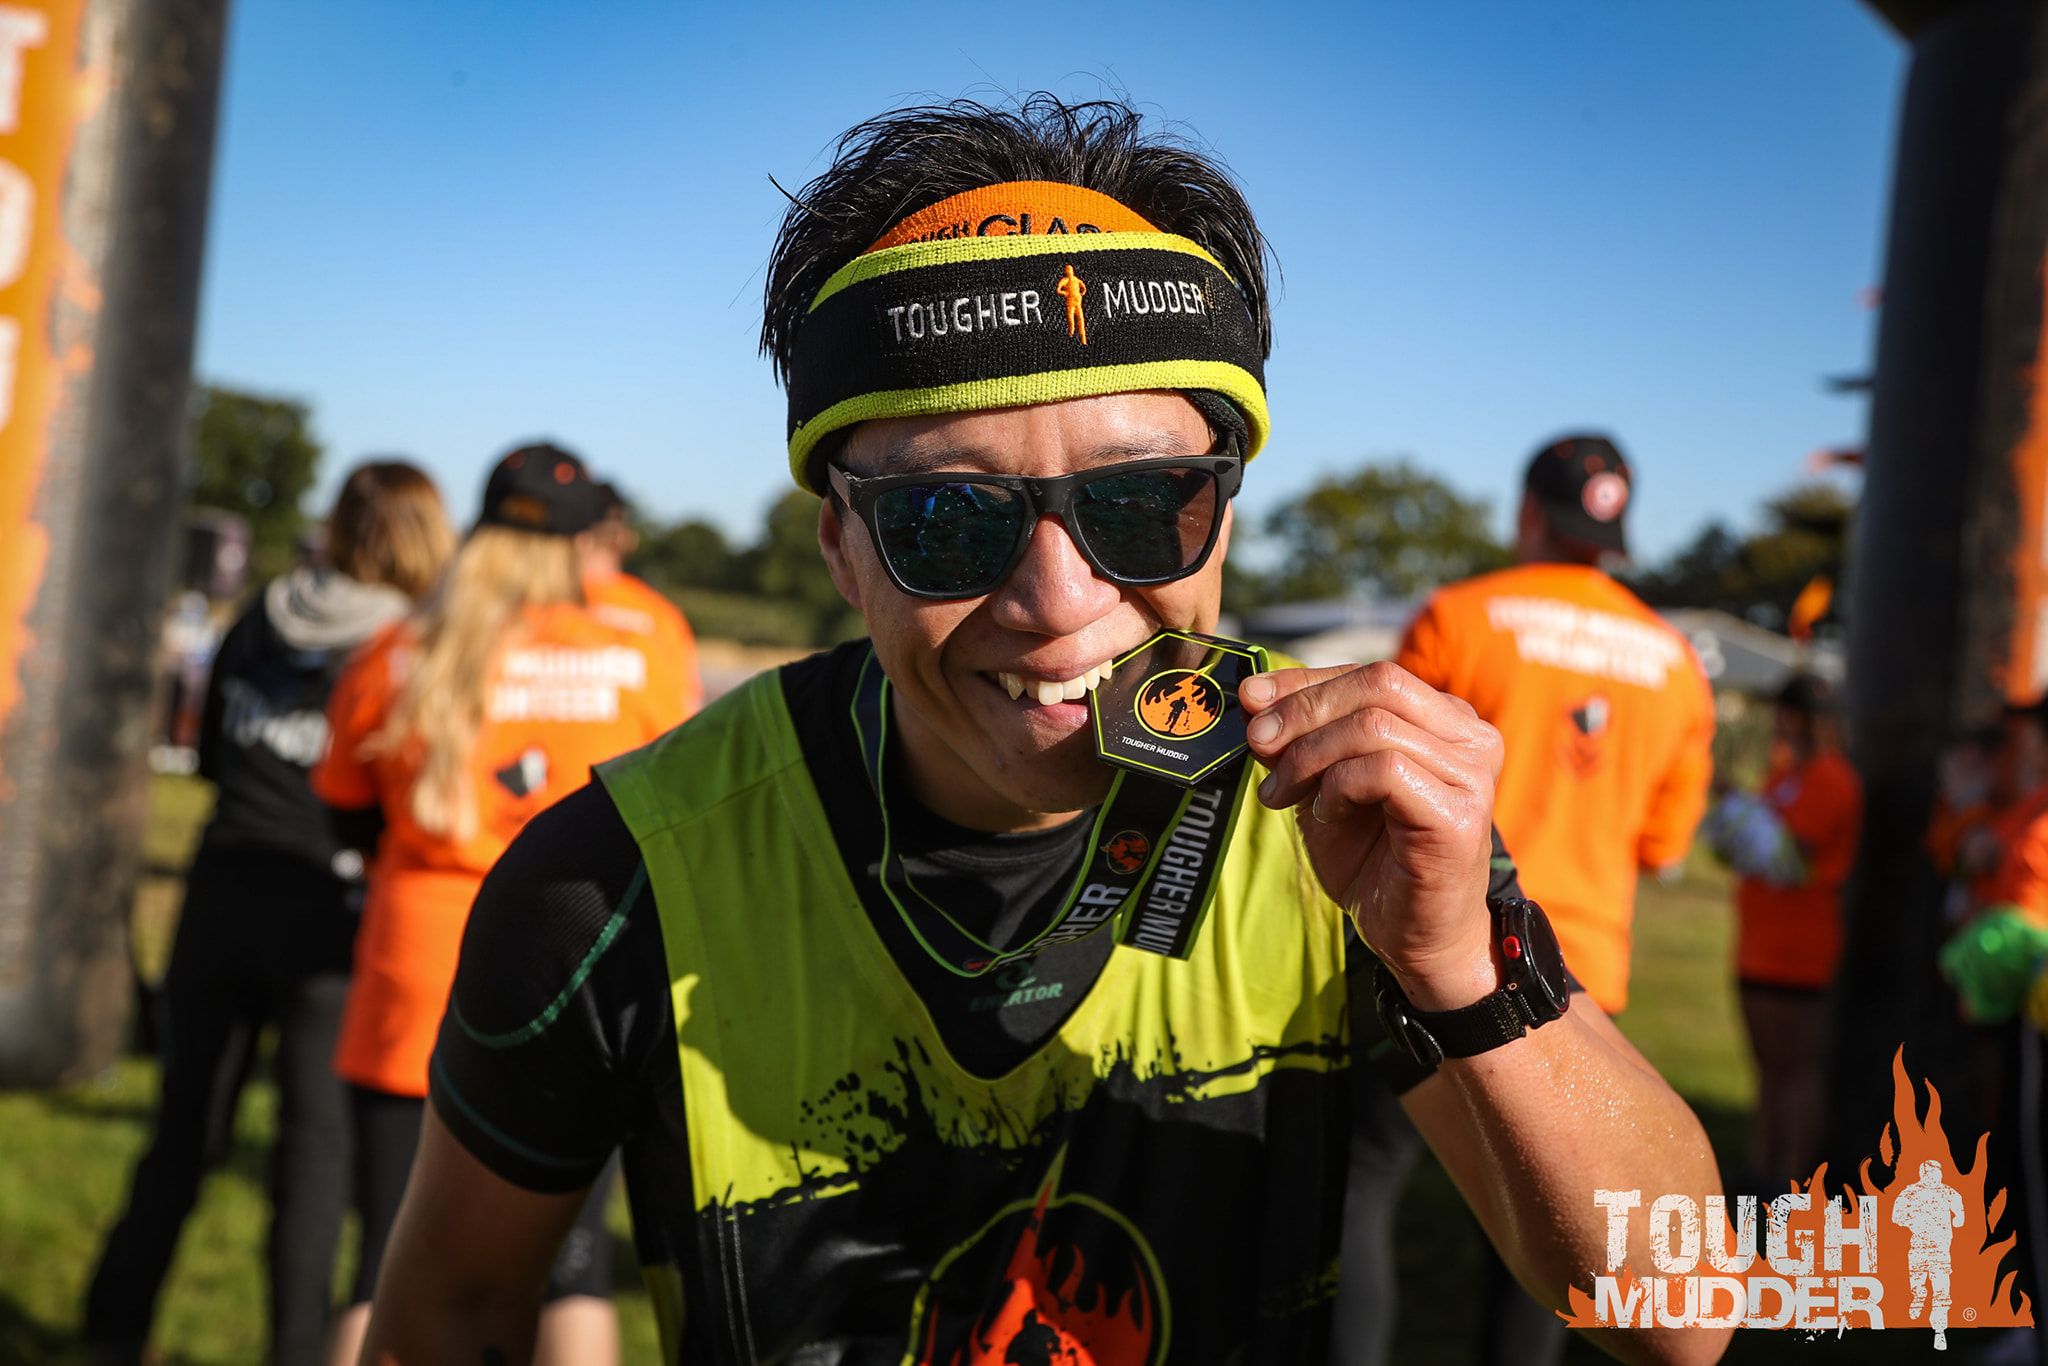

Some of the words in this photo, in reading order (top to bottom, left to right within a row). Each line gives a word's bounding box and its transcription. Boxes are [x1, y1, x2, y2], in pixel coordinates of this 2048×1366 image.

[888, 290, 1042, 344] TOUGHER
[1103, 279, 1207, 319] MUDDER
[1122, 736, 1156, 752] TOUGHER
[1156, 745, 1189, 762] MUDDER
[1147, 789, 1223, 913] TOUGHER
